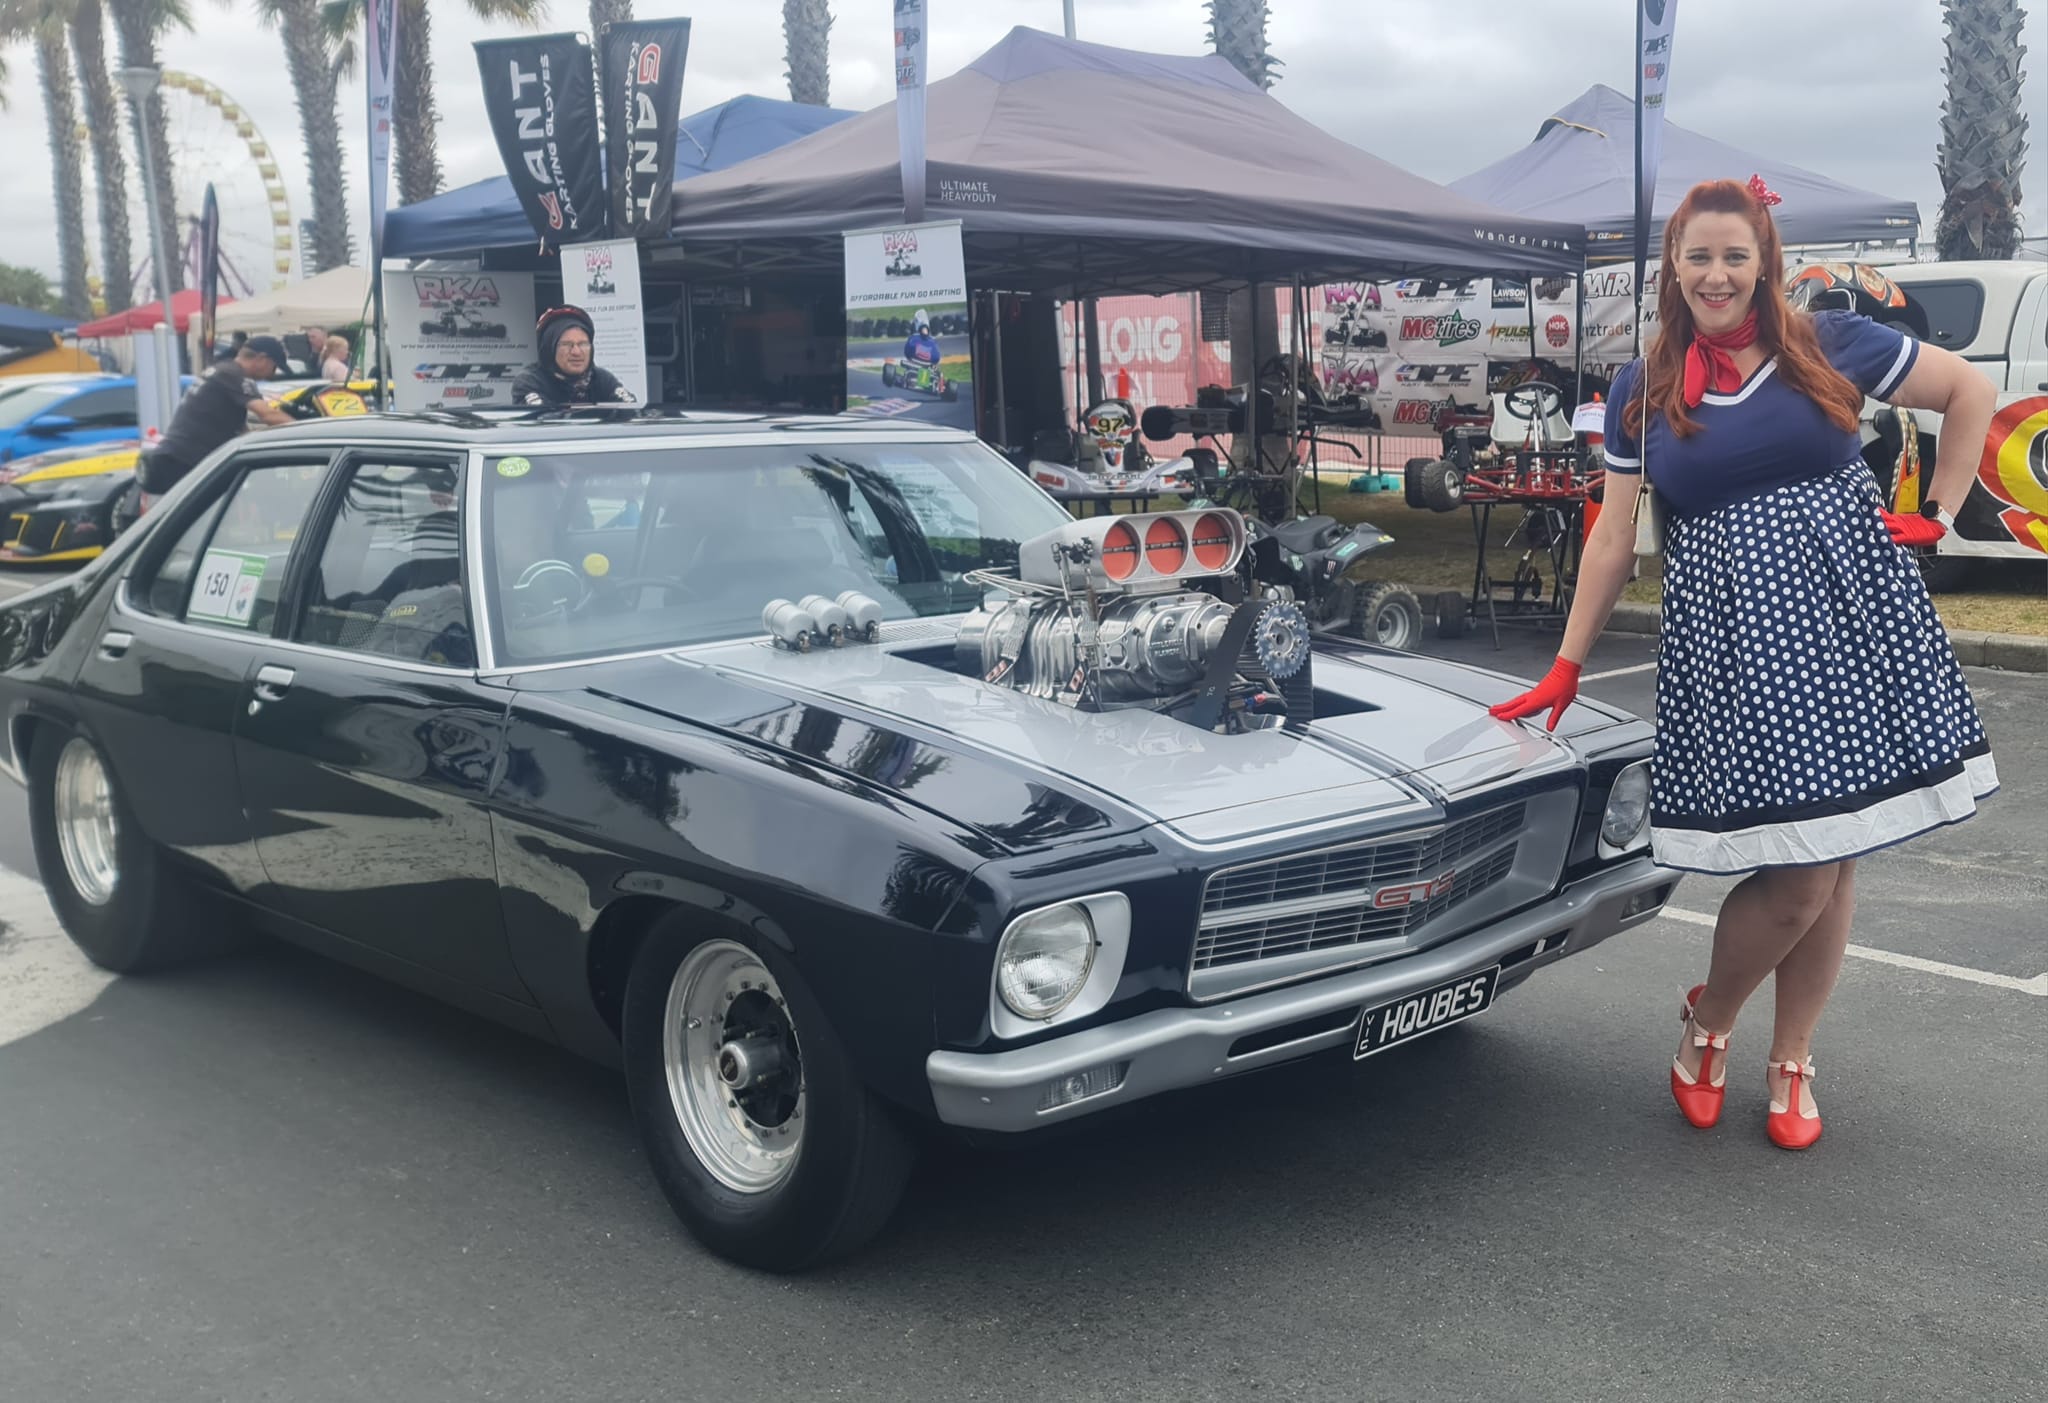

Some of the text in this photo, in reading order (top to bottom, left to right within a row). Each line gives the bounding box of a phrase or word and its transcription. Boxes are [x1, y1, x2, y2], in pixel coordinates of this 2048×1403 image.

[625, 41, 640, 135] KARTING
[540, 54, 578, 229] KARTING GLOVES
[634, 42, 661, 221] GANT
[940, 180, 989, 192] ULTIMATE
[941, 191, 997, 203] HEAVYDUTY
[882, 231, 918, 251] RKA
[413, 275, 500, 301] RKA
[901, 291, 916, 299] FUN
[929, 288, 961, 297] KARTING
[1493, 288, 1526, 298] LAWSON
[1399, 314, 1482, 341] MGtires
[1496, 325, 1537, 337] PULS
[331, 398, 360, 412] 72
[1098, 417, 1124, 433] 97
[204, 572, 229, 597] 150
[1373, 870, 1456, 909] GTS
[1379, 976, 1487, 1043] HQUBES
[1359, 1014, 1375, 1051] VIC
